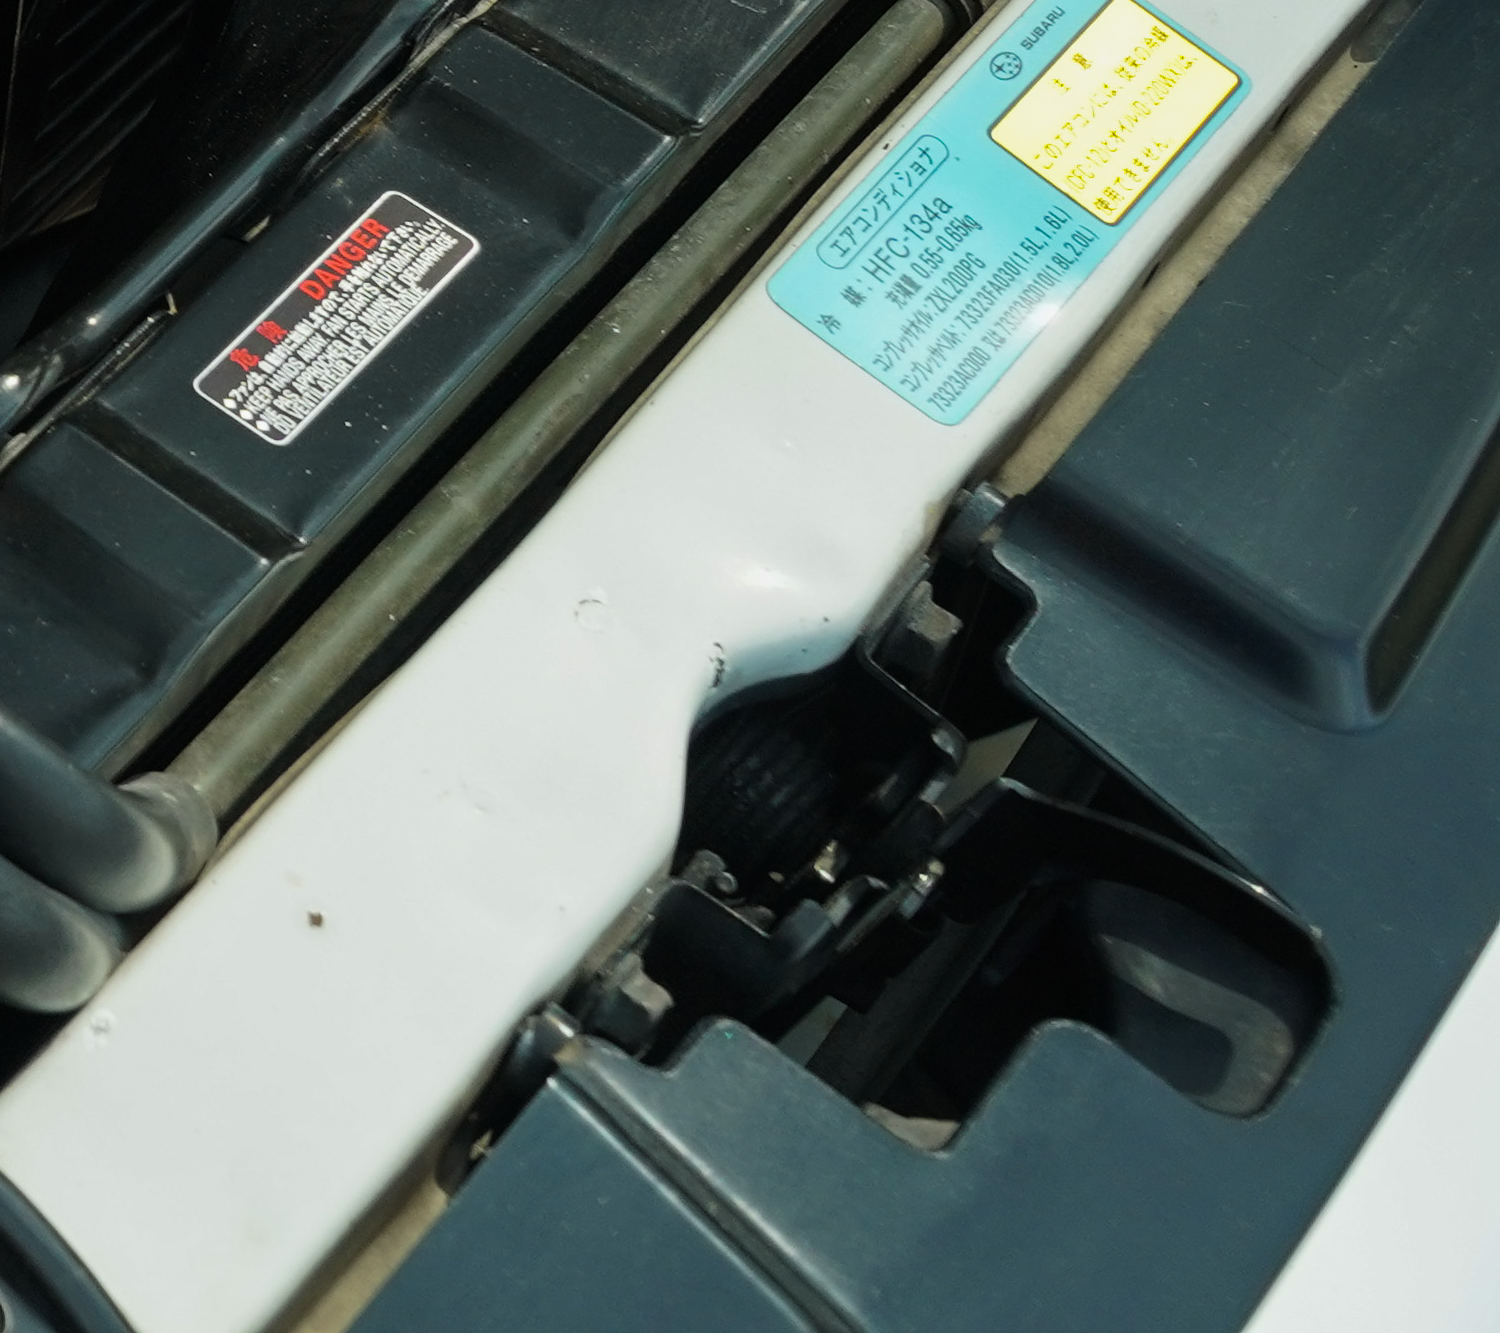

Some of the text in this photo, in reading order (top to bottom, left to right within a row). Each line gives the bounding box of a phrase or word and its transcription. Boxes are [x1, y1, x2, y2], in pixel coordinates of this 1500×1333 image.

[1017, 3, 1067, 53] SUBARU
[825, 141, 943, 261] エアコンディショナ
[860, 190, 955, 285] HFC-134a
[908, 208, 985, 284] 0.55-0.65kg
[295, 215, 392, 303] DANGER
[239, 383, 277, 416] KEEP
[263, 354, 307, 393] HANDS
[318, 313, 349, 339] FAN
[335, 280, 383, 322] STARTS
[368, 216, 448, 289] AUTOMATICALLY.
[256, 404, 282, 426] NE
[269, 385, 301, 412] PAS
[288, 336, 351, 394] APPROCHER
[337, 319, 369, 345] LES
[383, 278, 410, 300] LE
[270, 412, 298, 435] DU
[285, 355, 356, 420] VENTILATEUR
[341, 338, 372, 365] EST
[925, 344, 994, 414] 73323AC000
